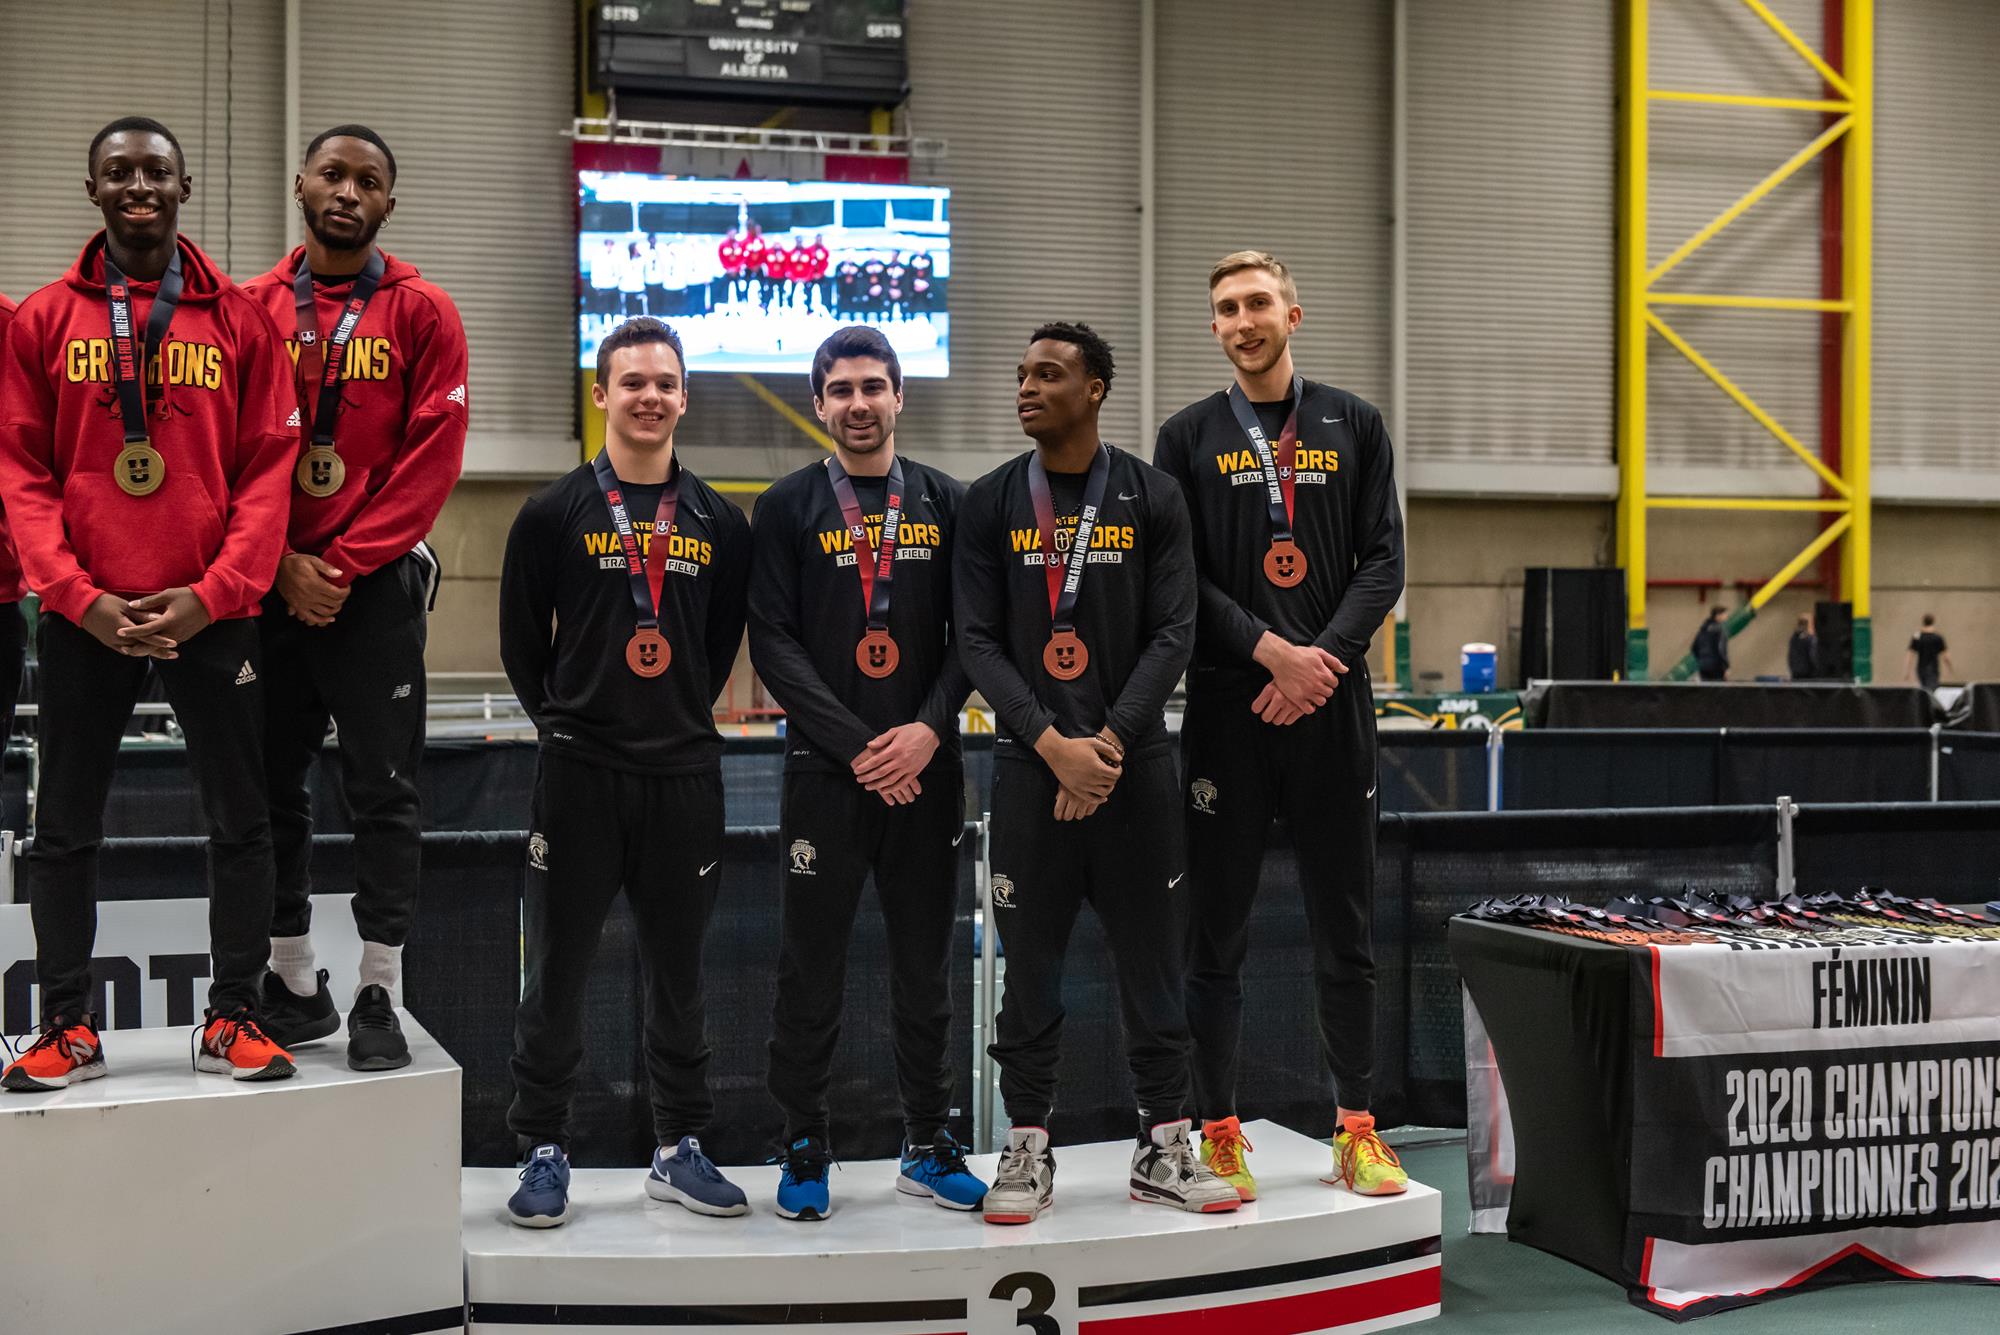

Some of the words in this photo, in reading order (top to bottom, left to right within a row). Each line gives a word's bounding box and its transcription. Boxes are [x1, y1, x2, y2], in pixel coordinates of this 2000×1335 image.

[603, 6, 639, 22] SETS
[867, 23, 902, 38] SETS
[708, 37, 799, 54] UNIVERSITY
[744, 52, 765, 65] OF
[721, 63, 788, 79] ALBERTA
[1216, 449, 1339, 475] WAORS
[1235, 473, 1264, 484] TRAC
[584, 532, 712, 565] WAORS
[902, 549, 929, 559] FIELD
[1090, 553, 1119, 562] FIELD
[668, 561, 696, 575] FIELD
[1812, 948, 1931, 1029] FÉMININ
[1726, 1066, 1812, 1147] 2020
[539, 1148, 553, 1156] NIKE
[1703, 1142, 1939, 1229] CHAMPIONNES
[989, 1271, 1061, 1335] 3
